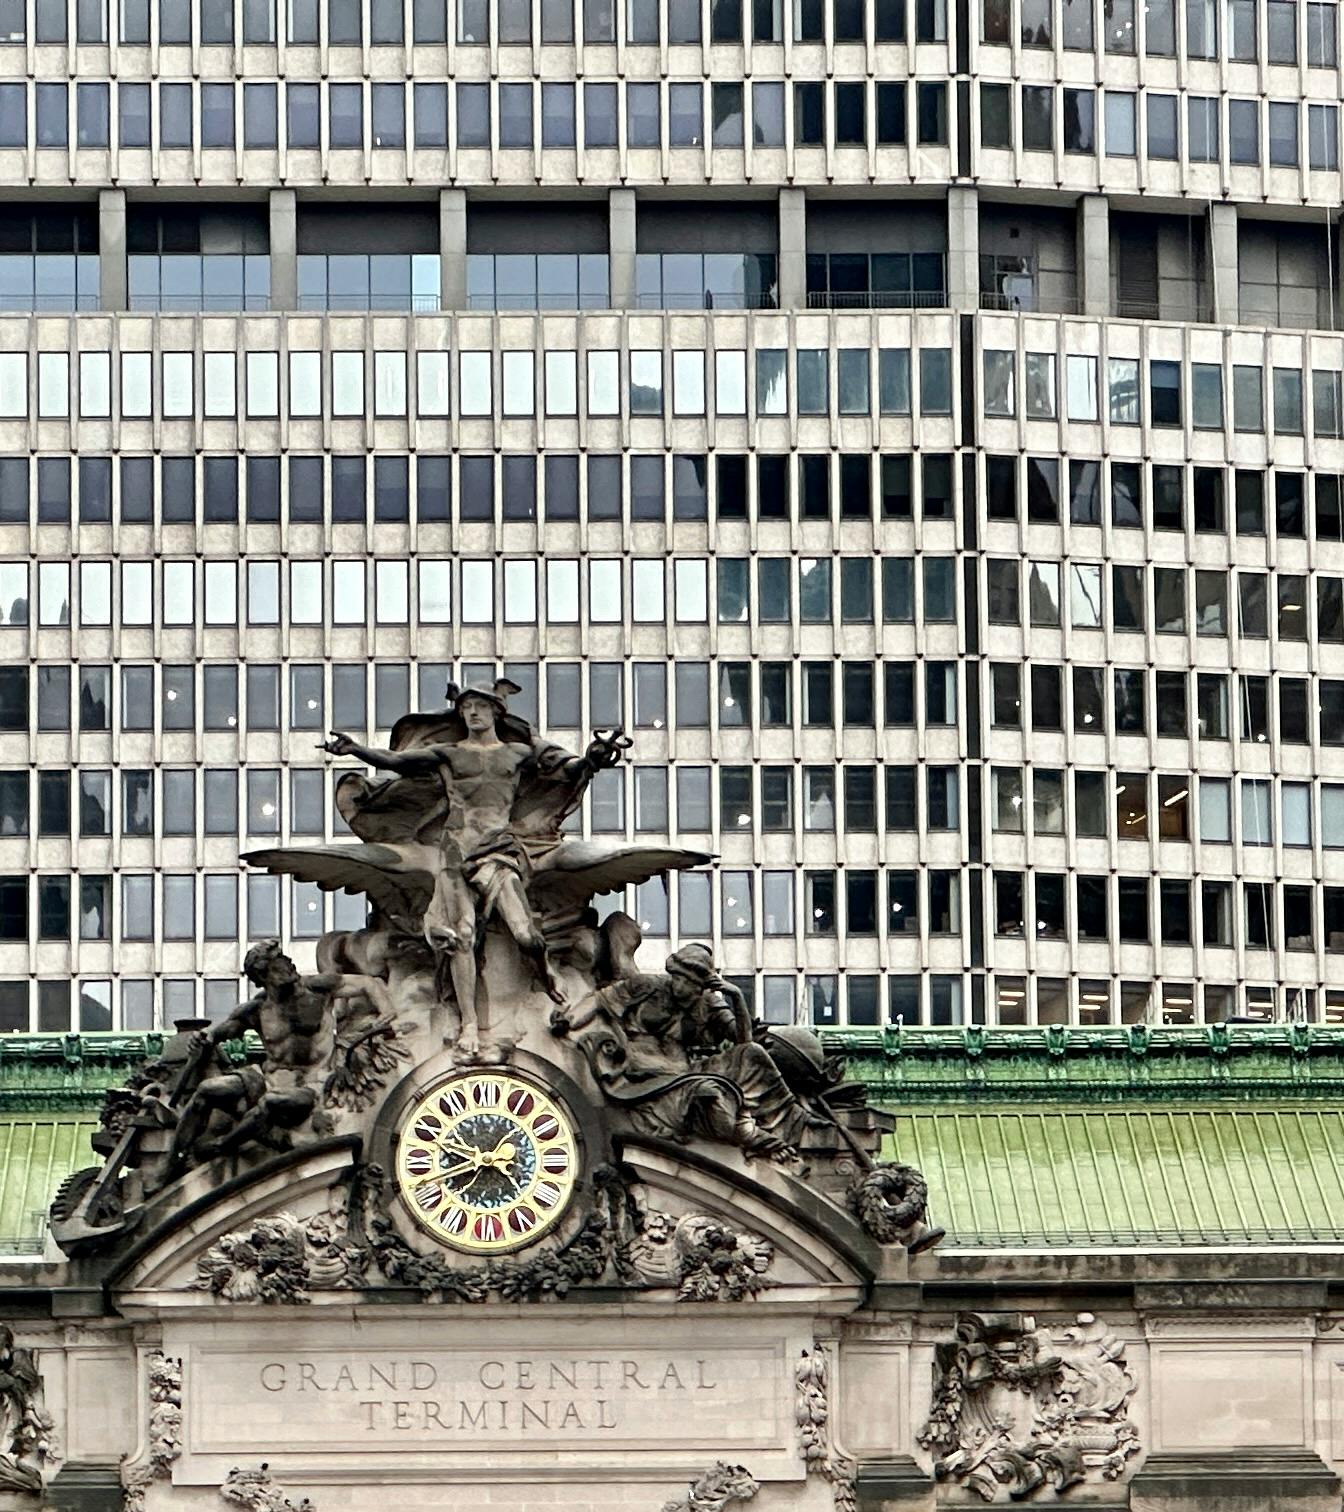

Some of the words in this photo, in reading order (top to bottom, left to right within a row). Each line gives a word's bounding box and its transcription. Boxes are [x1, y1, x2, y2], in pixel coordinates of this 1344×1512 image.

[440, 1089, 465, 1118] XI
[477, 1081, 497, 1107] XII
[415, 1117, 442, 1139] X
[533, 1117, 559, 1137] II
[440, 1206, 463, 1233] VII
[480, 1214, 496, 1241] VI
[514, 1208, 534, 1233] V
[260, 1361, 437, 1392] GRAND
[479, 1359, 717, 1390] CENTRAL
[359, 1400, 616, 1430] TERMINAL
